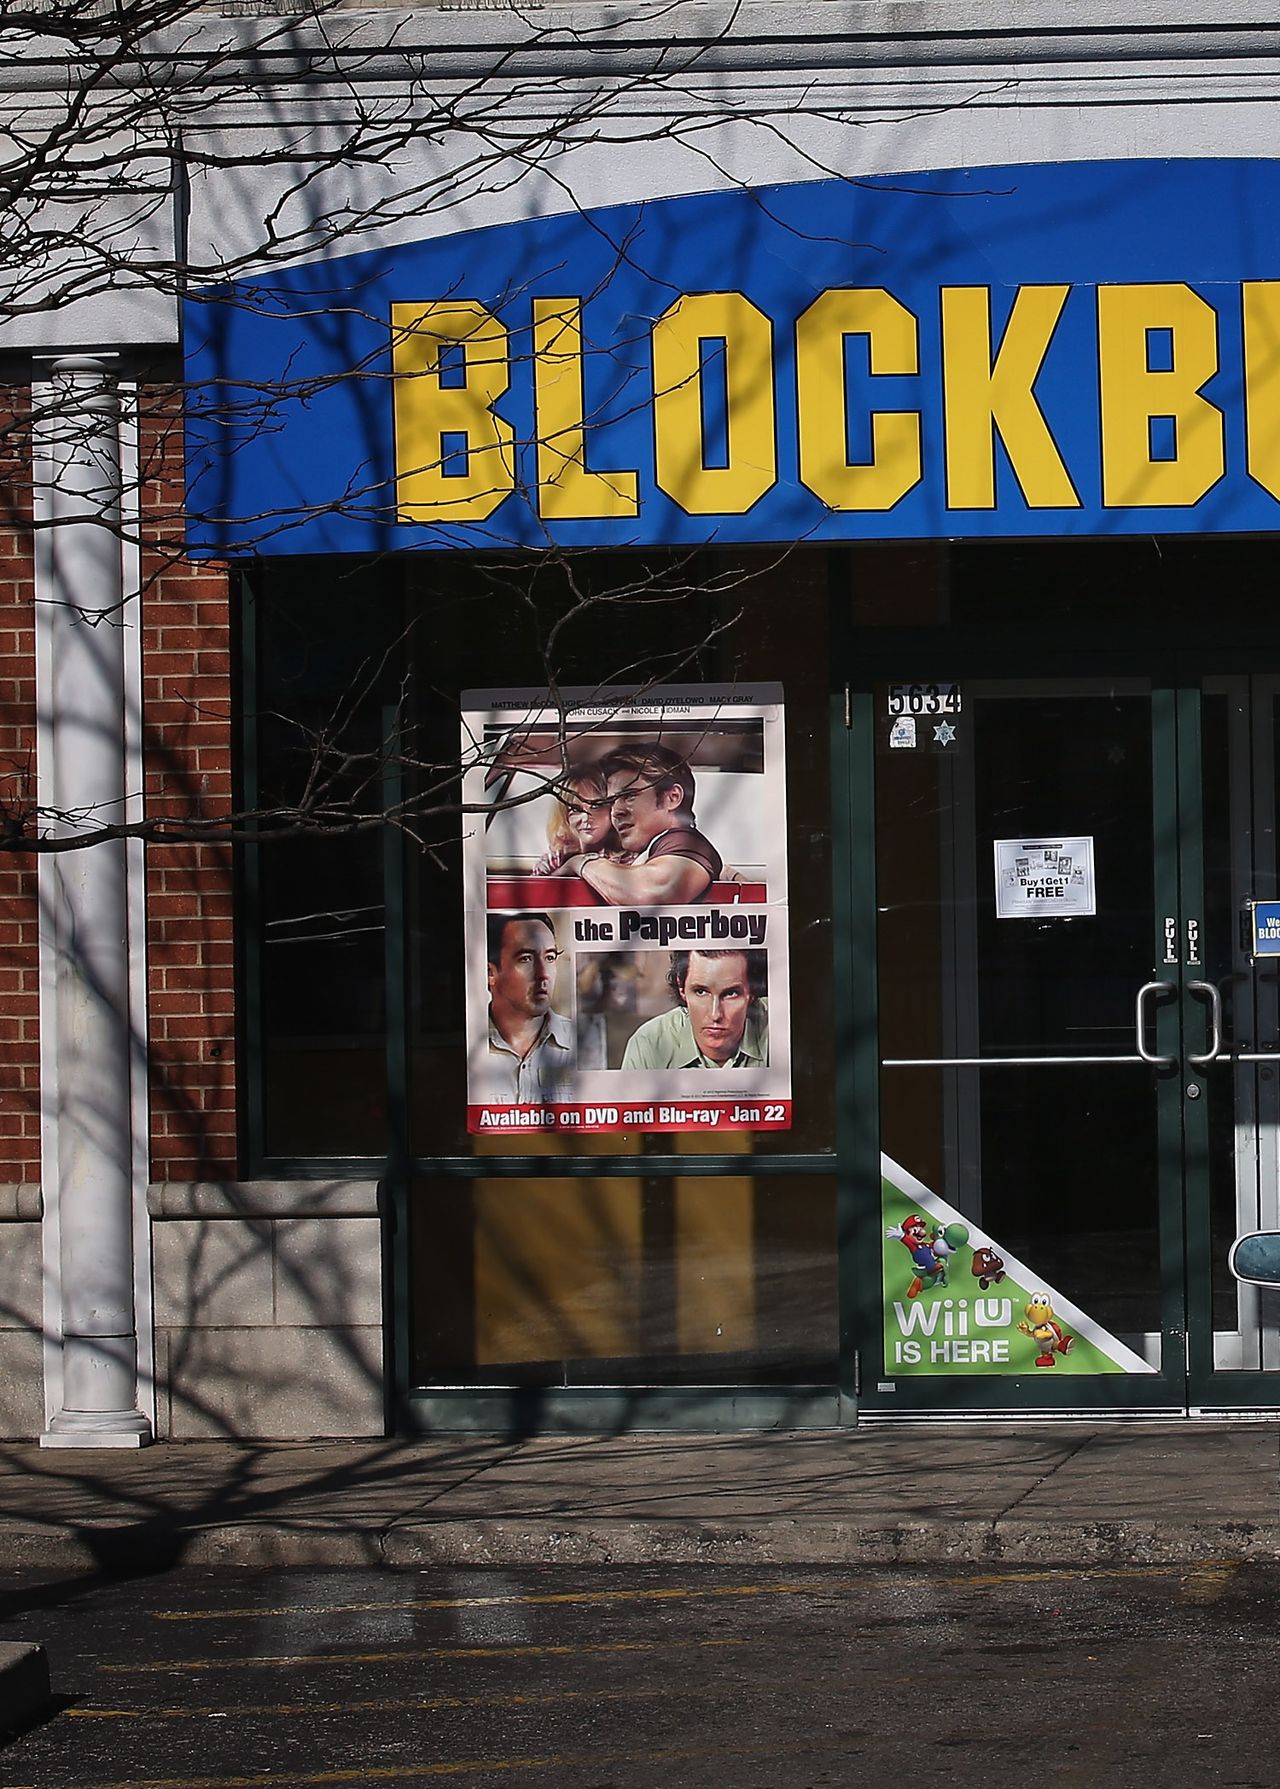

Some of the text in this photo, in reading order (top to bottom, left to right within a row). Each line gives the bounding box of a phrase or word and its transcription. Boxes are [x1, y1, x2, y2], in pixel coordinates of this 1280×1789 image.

[631, 707, 659, 715] NICOLE
[889, 684, 961, 714] 5634
[1020, 878, 1038, 886] Buy
[1027, 886, 1065, 898] FREE
[574, 909, 768, 947] the Paperboy
[1165, 917, 1175, 958] PULL
[1188, 919, 1198, 960] PULL
[480, 1110, 556, 1127] Available
[559, 1111, 580, 1125] on
[585, 1108, 618, 1125] DVD
[623, 1108, 654, 1123] and
[729, 1107, 760, 1122] Jan
[764, 1105, 785, 1121] 22
[893, 1300, 968, 1337] Wii
[895, 1340, 1010, 1364] IS HERE
